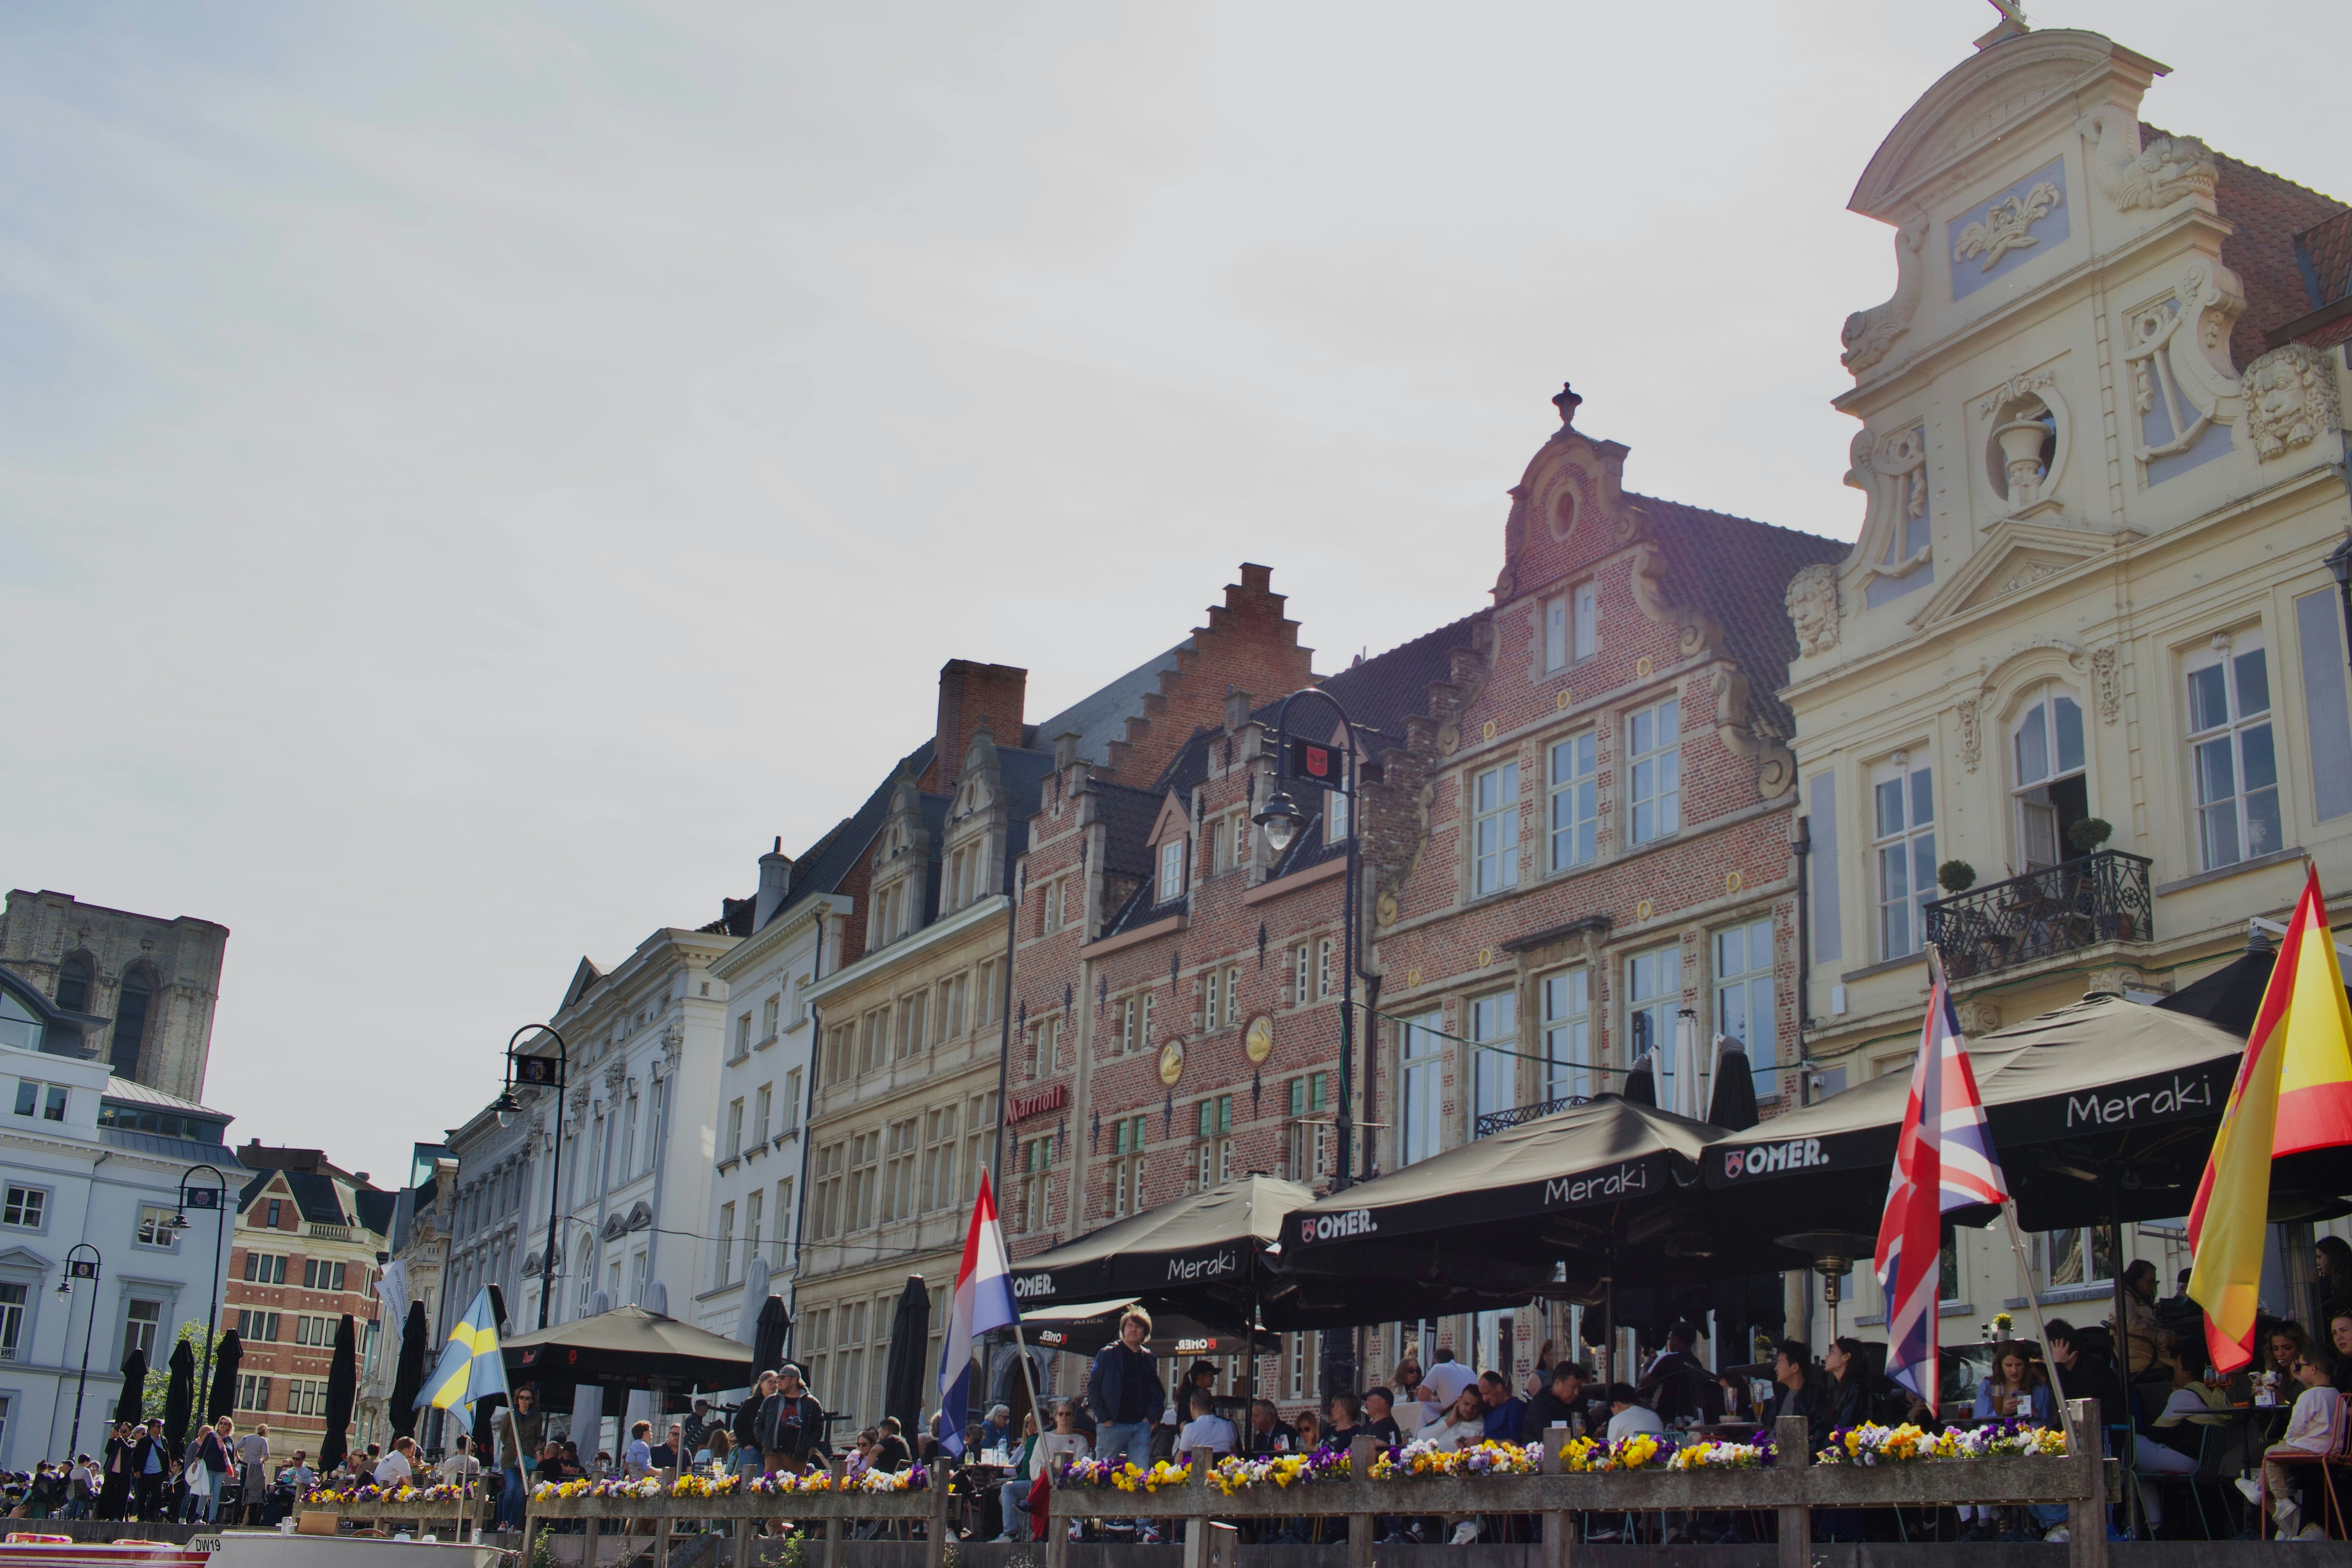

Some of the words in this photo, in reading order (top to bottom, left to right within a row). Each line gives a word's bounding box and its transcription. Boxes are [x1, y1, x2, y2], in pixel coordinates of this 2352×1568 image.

[1003, 1085, 1063, 1126] Marriott
[2067, 1075, 2211, 1127] Meraki
[1544, 1164, 1646, 1205] Meraki
[1167, 1250, 1235, 1280] Meraki
[196, 1539, 220, 1551] DW19
